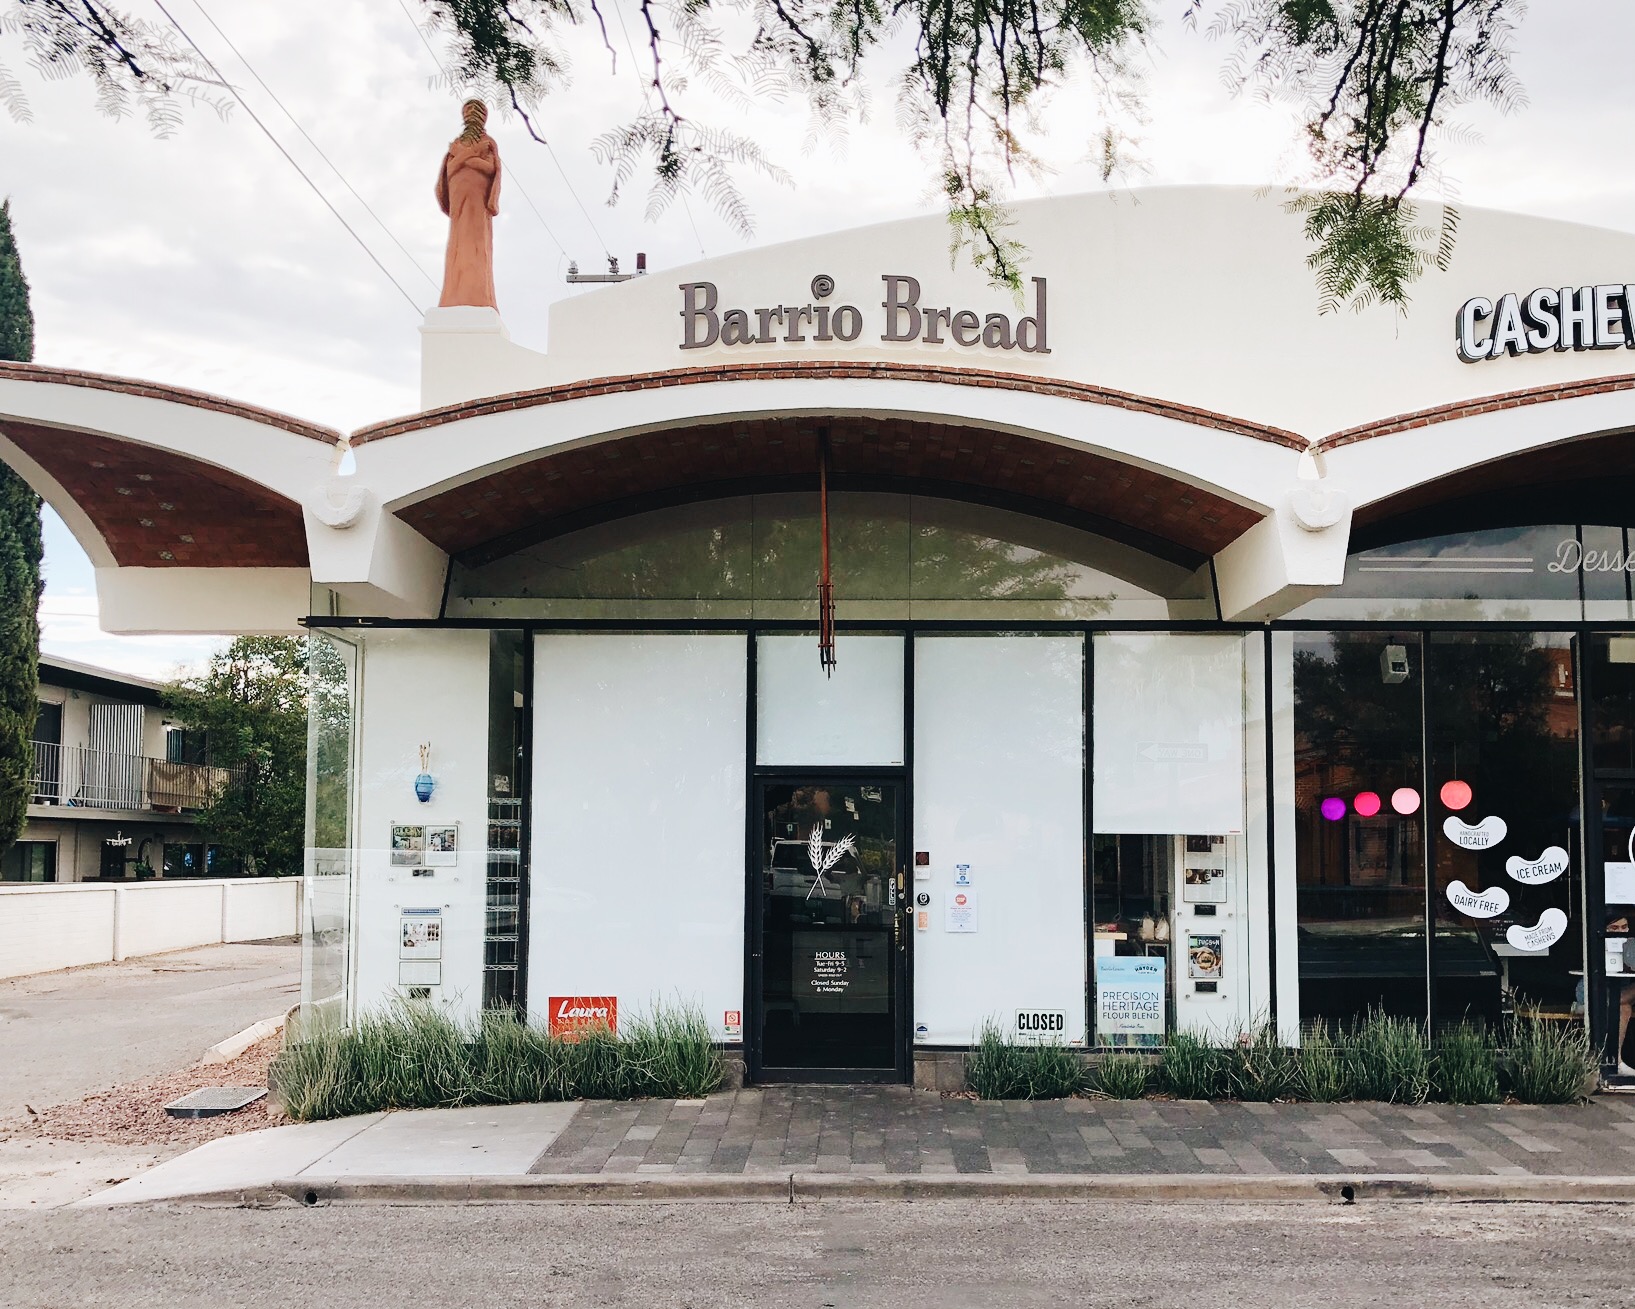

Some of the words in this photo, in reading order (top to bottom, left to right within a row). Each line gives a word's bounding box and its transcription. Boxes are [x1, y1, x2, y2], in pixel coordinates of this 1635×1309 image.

[678, 274, 863, 350] Barrio
[880, 274, 1052, 354] Bread
[1456, 284, 1635, 364] CASHE
[1460, 836, 1489, 846] LOCALLY
[1516, 868, 1531, 879] ICE
[1532, 862, 1562, 877] CREAM
[1454, 894, 1478, 908] DAIRY
[1479, 900, 1499, 914] FREE
[1525, 931, 1538, 941] MADE
[1539, 926, 1553, 936] FROM
[1527, 932, 1555, 948] CASHEWS
[815, 951, 846, 959] HOURS
[1102, 991, 1159, 1001] PRECISION
[557, 999, 609, 1019] Laura
[1102, 1001, 1159, 1012] HERITAGE
[1018, 1013, 1064, 1031] CLOSED
[1102, 1012, 1130, 1020] FLOUR
[1132, 1012, 1160, 1020] BLEND
